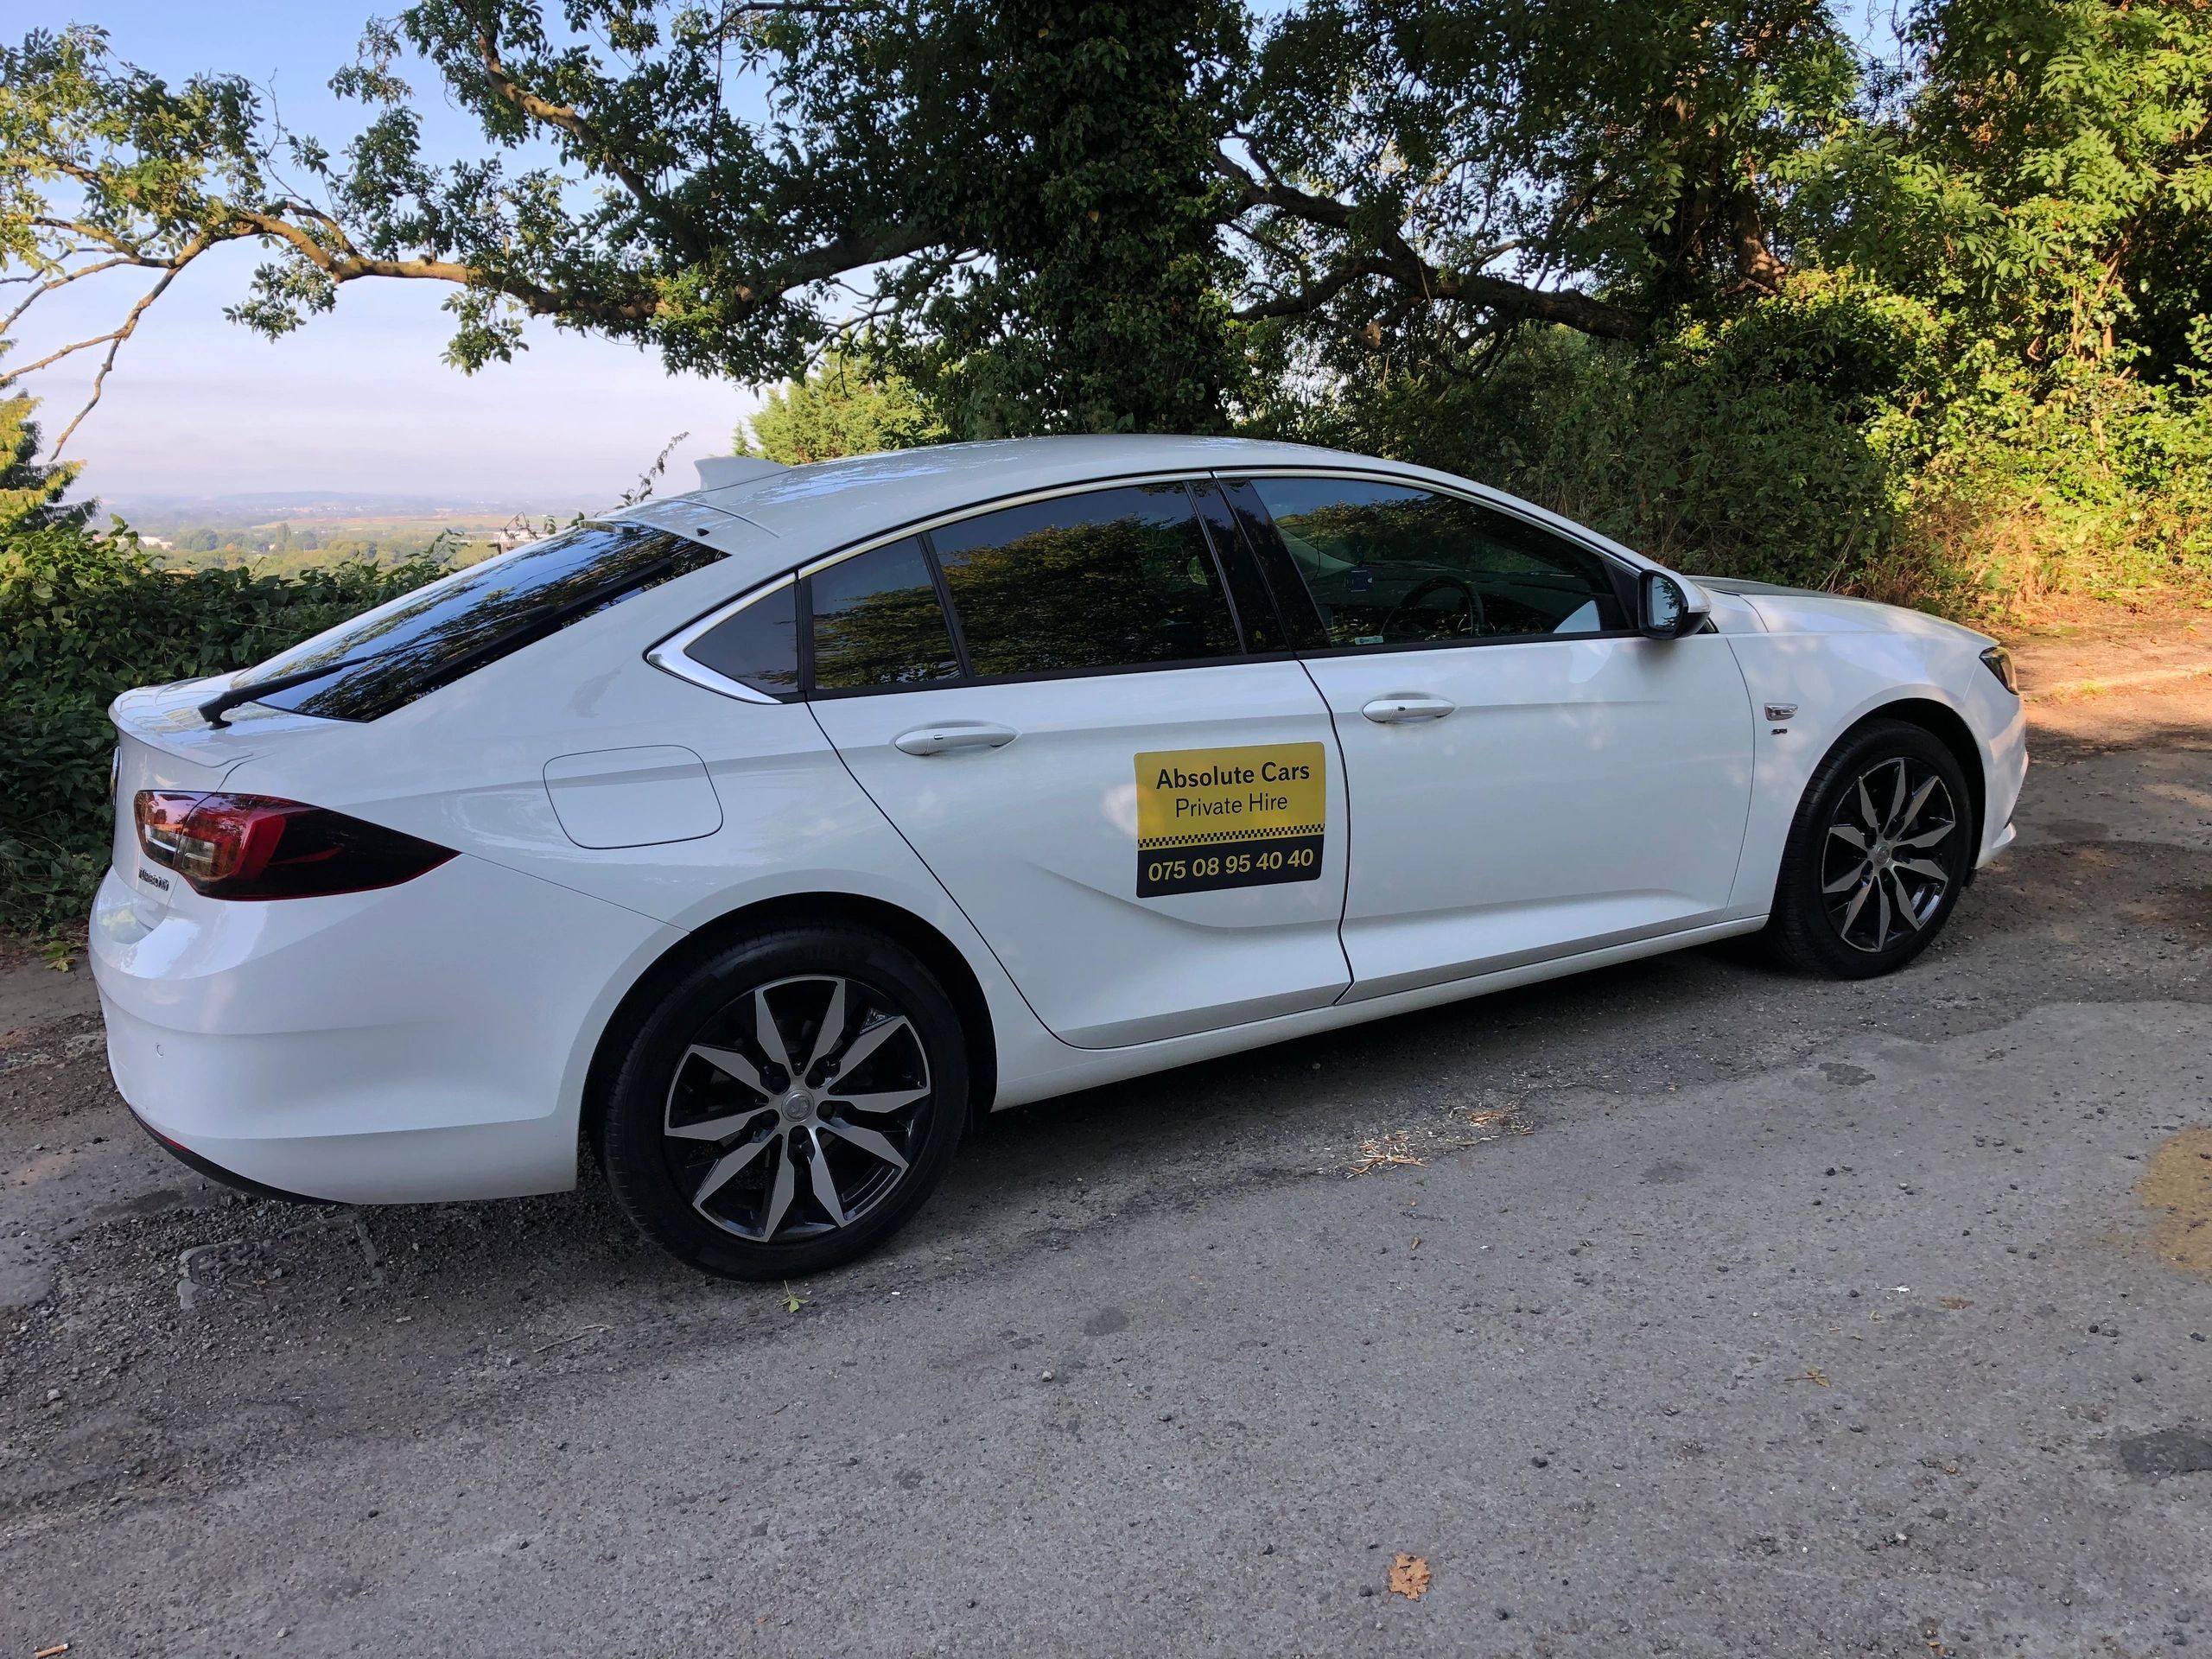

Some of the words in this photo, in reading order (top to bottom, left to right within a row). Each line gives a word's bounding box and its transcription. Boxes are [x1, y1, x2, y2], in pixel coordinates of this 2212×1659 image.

[1156, 766, 1255, 790] Absolute
[1261, 761, 1310, 783] Cars
[1175, 797, 1243, 818] Private
[1249, 792, 1287, 812] Hire
[1147, 861, 1186, 882] 075
[1192, 857, 1220, 877] 08
[1225, 854, 1251, 874] 95
[1255, 851, 1283, 871] 40
[1287, 849, 1314, 868] 40
